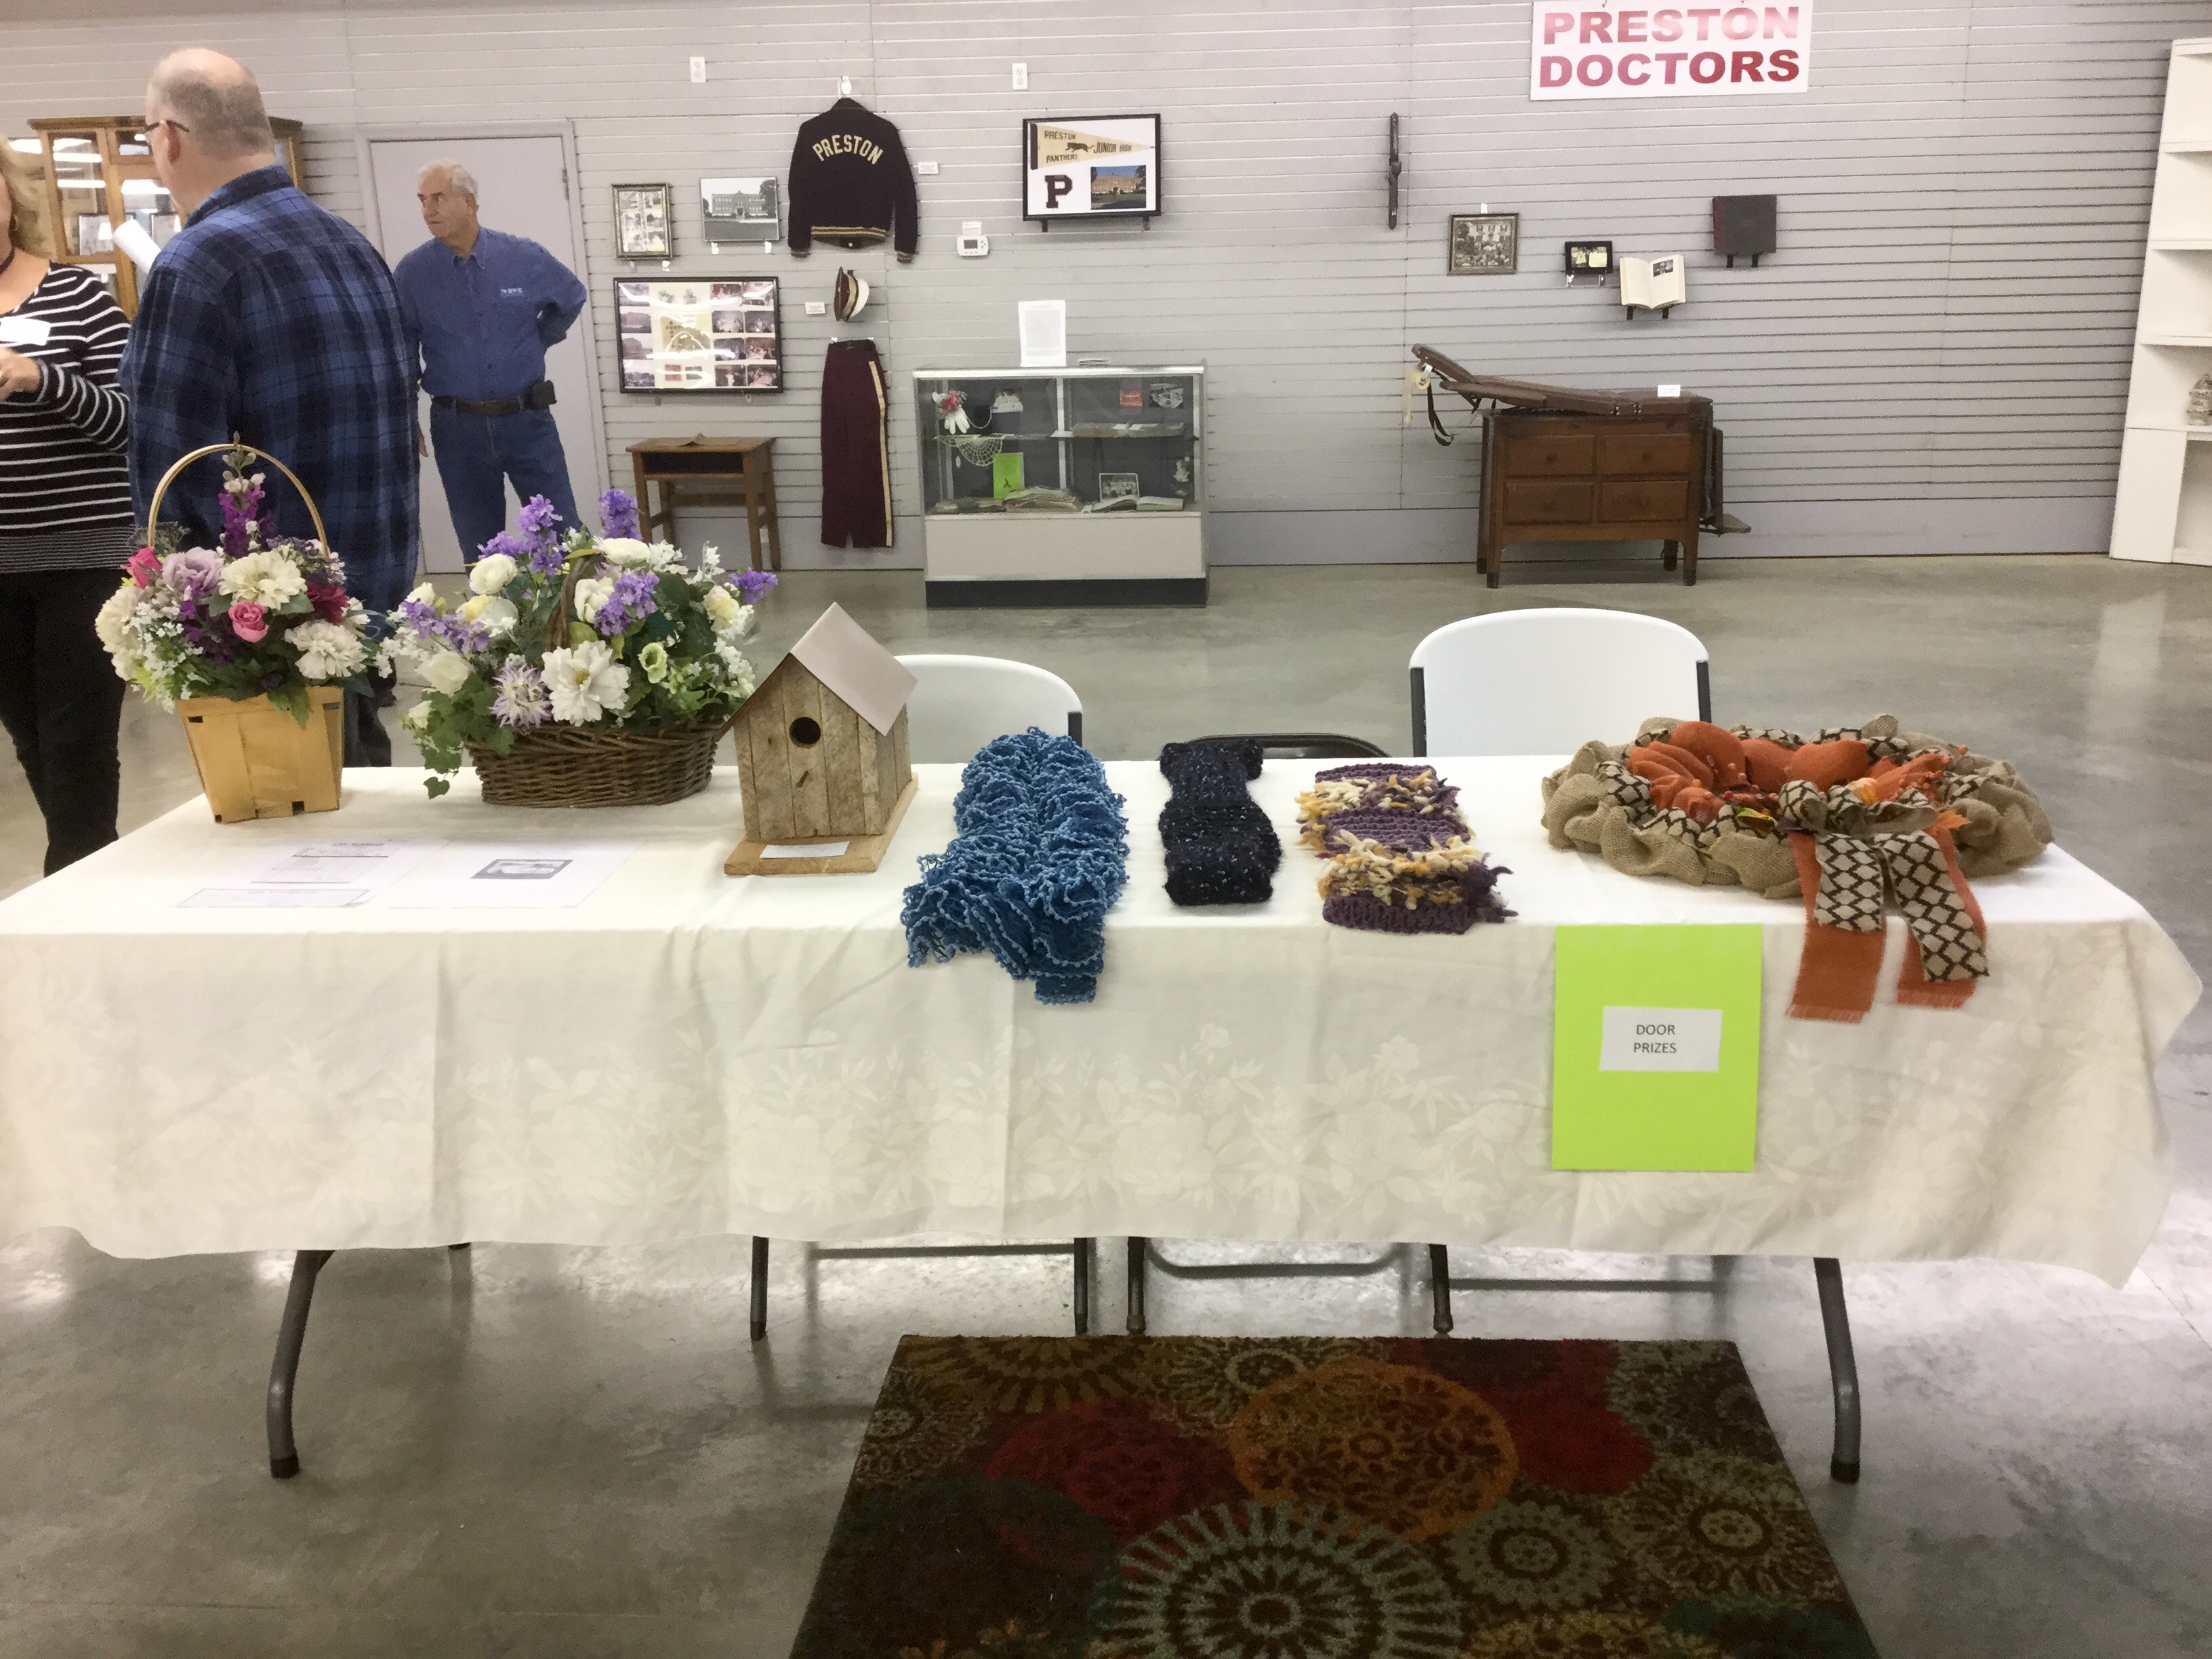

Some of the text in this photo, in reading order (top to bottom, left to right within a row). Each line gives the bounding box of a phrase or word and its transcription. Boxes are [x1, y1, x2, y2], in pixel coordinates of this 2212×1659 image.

[1543, 6, 1799, 45] PRESTON
[1539, 49, 1799, 87] DOCTORS
[1044, 130, 1076, 140] PRESTON
[812, 134, 884, 165] PRESTON
[1094, 142, 1132, 154] JUNIOR HIGH
[1046, 153, 1078, 163] PANTHERS
[1044, 174, 1073, 209] P
[1636, 1024, 1676, 1036] DOOR
[1633, 1042, 1677, 1053] PRIZES
